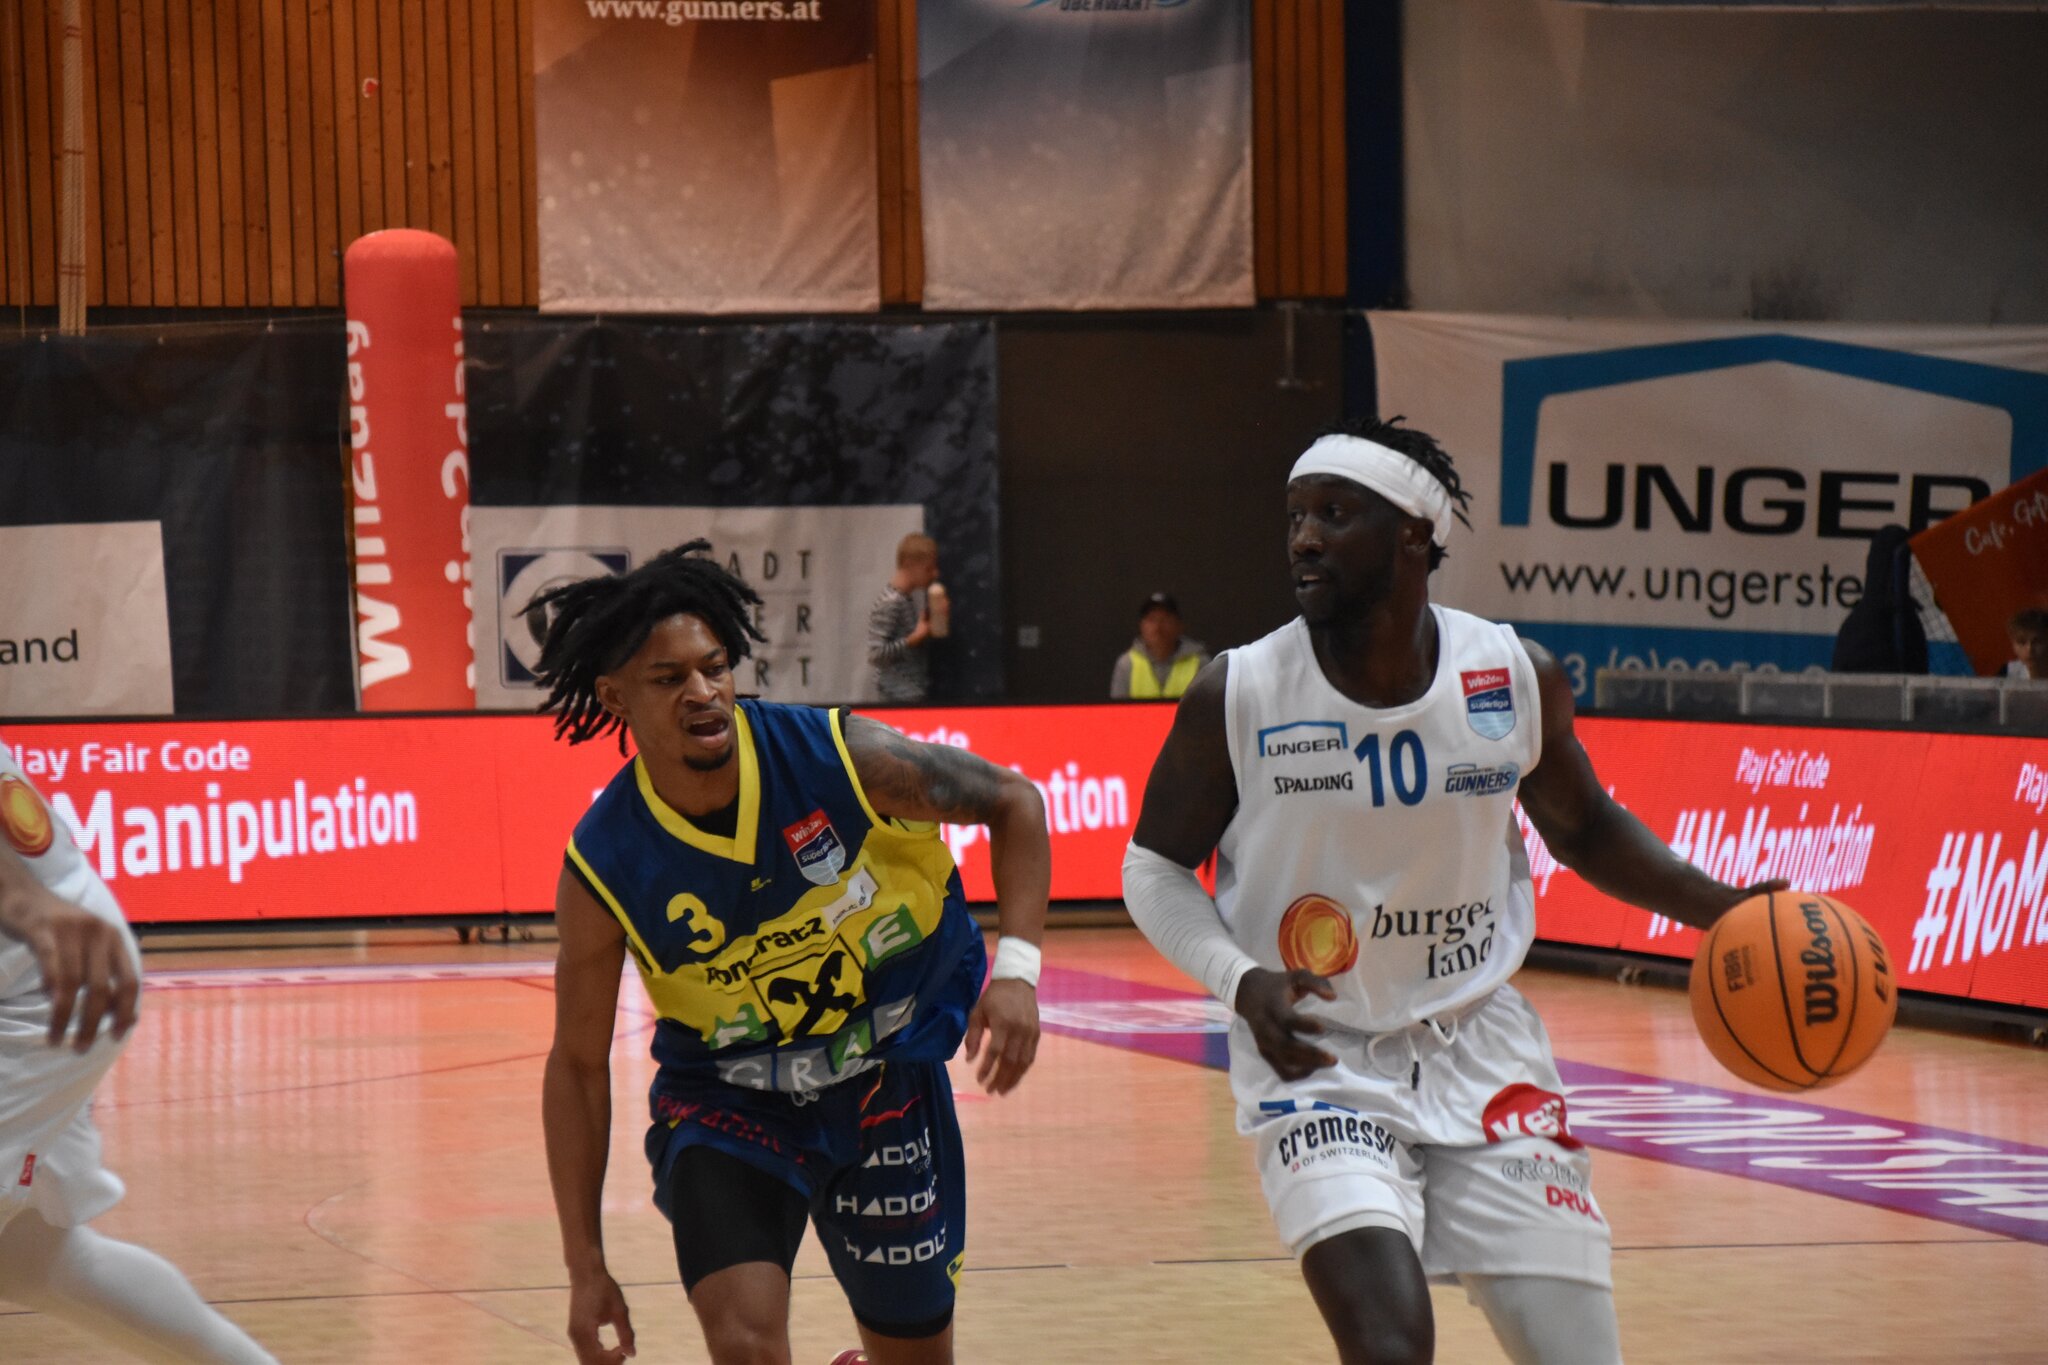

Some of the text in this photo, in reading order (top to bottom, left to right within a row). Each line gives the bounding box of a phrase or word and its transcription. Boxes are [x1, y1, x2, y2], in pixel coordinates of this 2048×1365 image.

[586, 0, 821, 26] www.gunners.at
[5, 740, 250, 782] lay Fair Code
[1267, 738, 1341, 757] UNGER
[1353, 729, 1428, 808] 10
[1274, 771, 1354, 795] SPALDING
[1445, 770, 1512, 793] GUNNERS
[1736, 746, 1831, 795] Play Fair Code
[666, 892, 726, 954] 3
[1799, 901, 1840, 1027] Wilson
